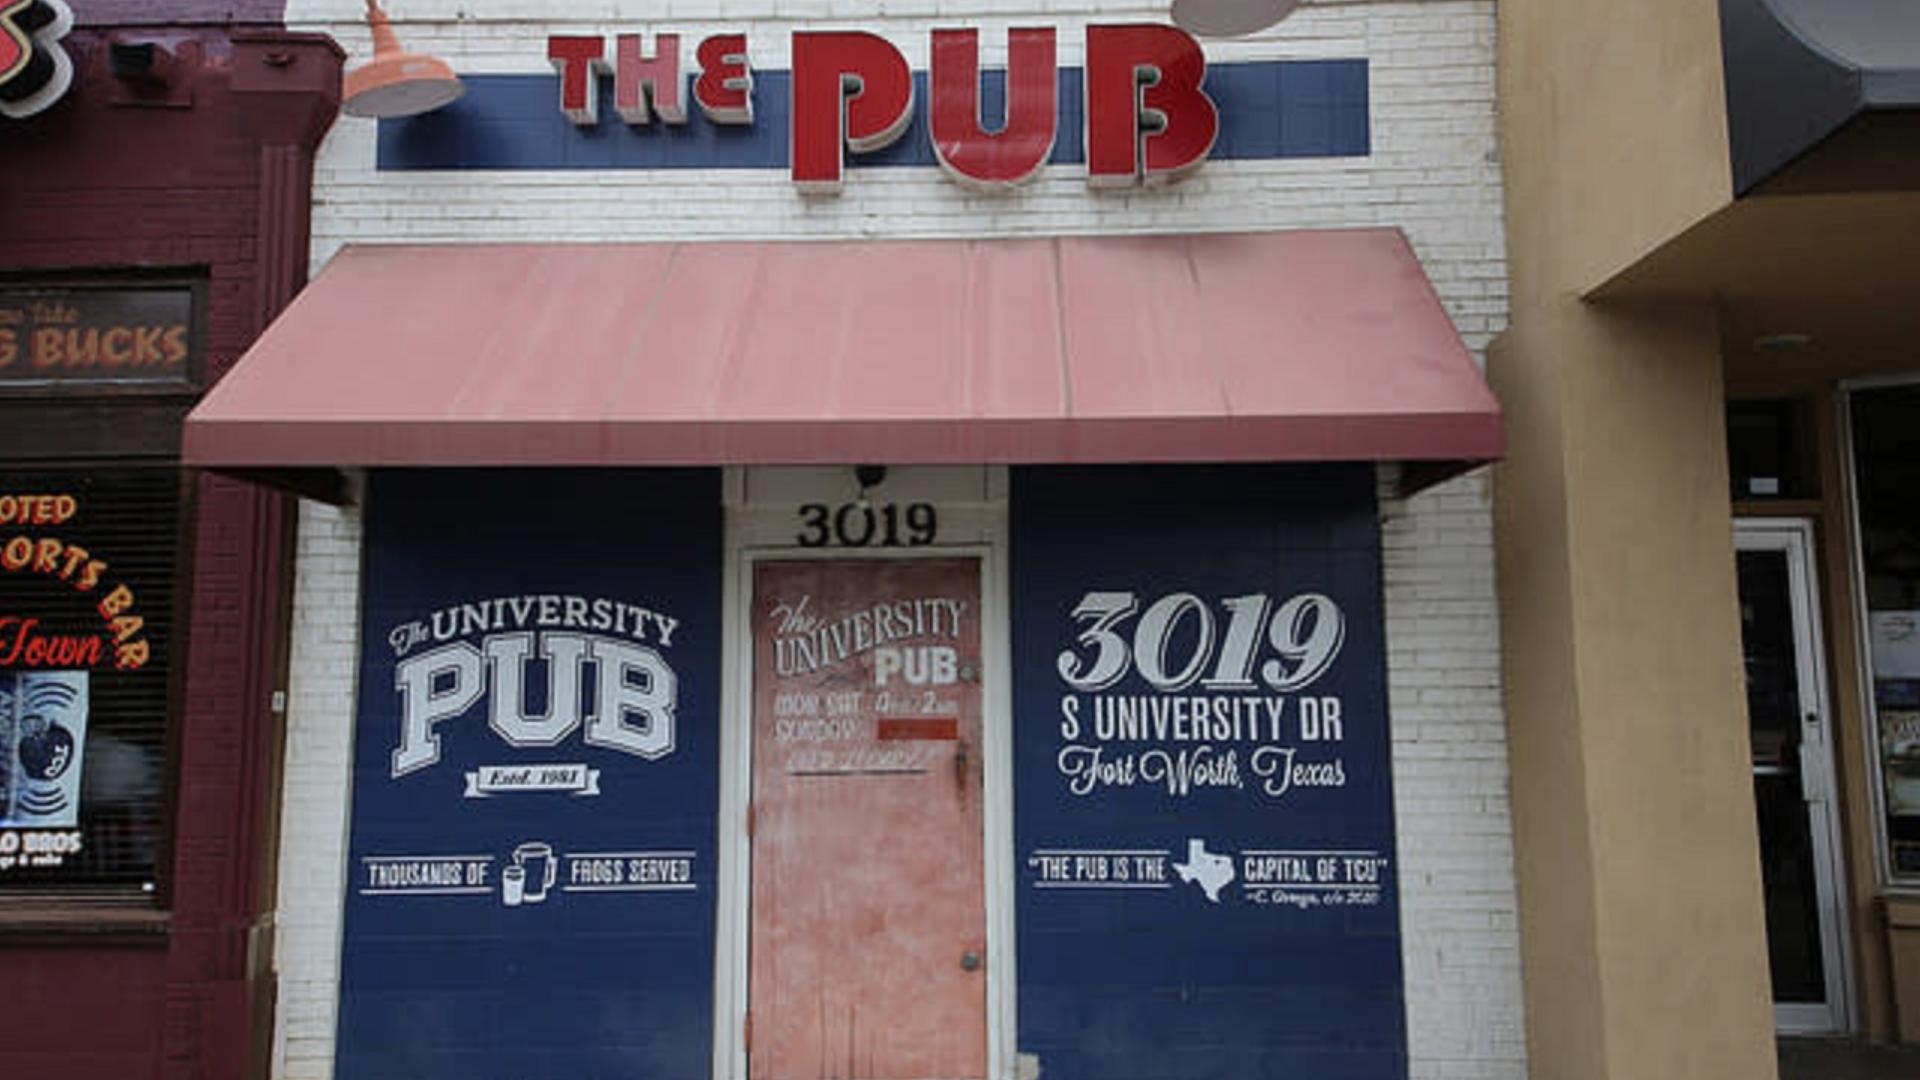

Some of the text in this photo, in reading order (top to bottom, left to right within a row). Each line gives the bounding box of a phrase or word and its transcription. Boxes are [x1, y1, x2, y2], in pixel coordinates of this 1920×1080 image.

[547, 22, 1219, 197] THE PUB
[32, 324, 188, 368] BUCKS
[797, 502, 938, 548] 3019
[0, 535, 150, 670] ORTS BAR
[388, 594, 680, 656] The UNIVERSITY
[774, 597, 968, 677] UNIVERSITY
[1057, 591, 1347, 693] 3019
[874, 645, 958, 687] PUB
[390, 630, 679, 780] PUB
[1061, 695, 1343, 741] S UNIVERSITY DR
[1057, 745, 1347, 797] Fort Worth, Texas
[369, 858, 691, 887] THOUSANDS OF FROGS SERVED
[1075, 856, 1109, 881] PUB
[1112, 856, 1130, 881] IS
[1134, 856, 1167, 881] THE
[1244, 857, 1313, 882] CAPITAL
[1317, 857, 1338, 881] OF
